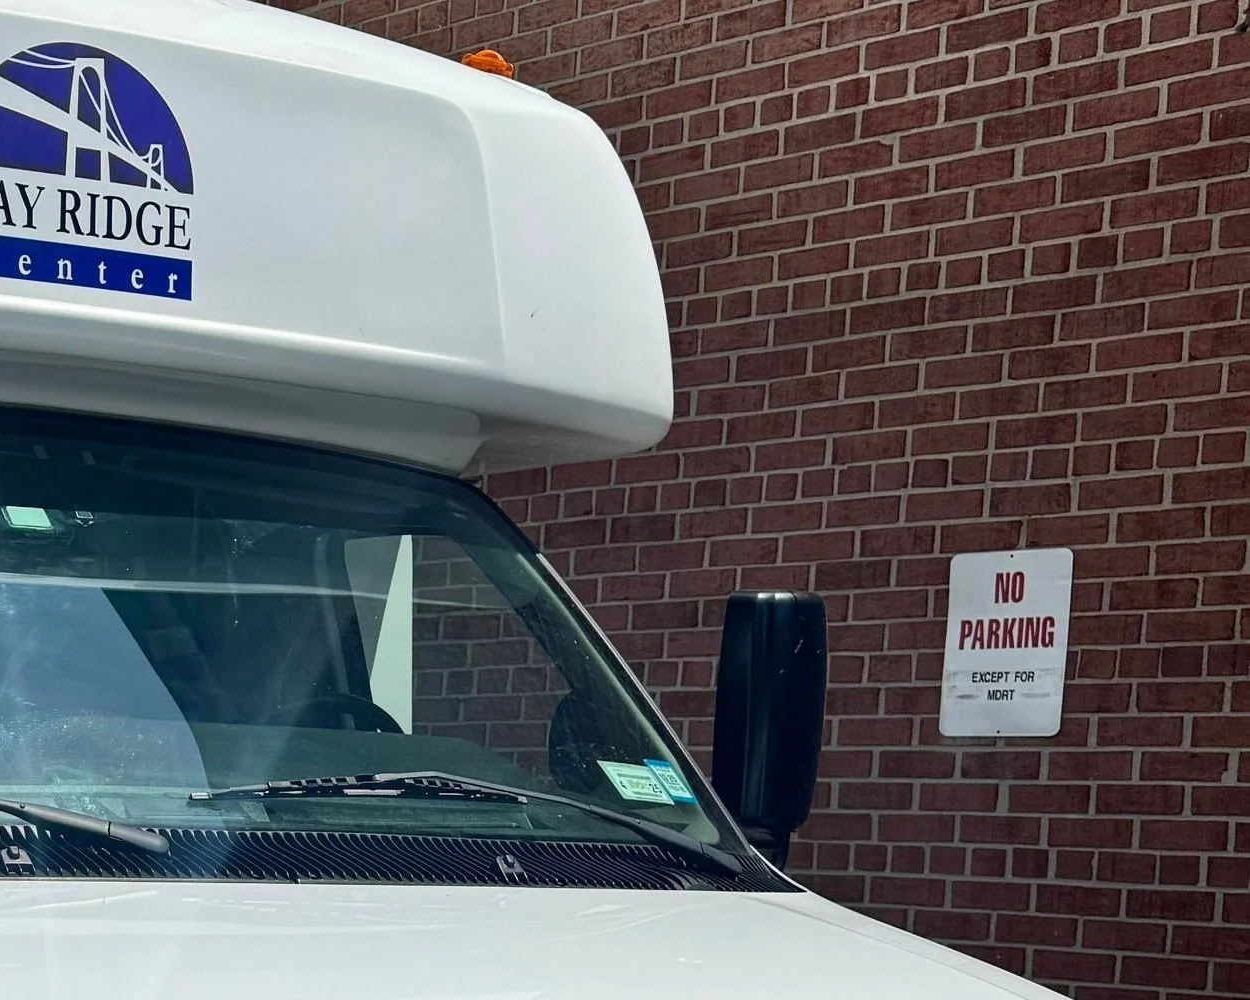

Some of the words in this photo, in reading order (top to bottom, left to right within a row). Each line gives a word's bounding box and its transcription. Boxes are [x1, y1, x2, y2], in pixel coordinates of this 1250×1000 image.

[56, 188, 192, 251] RIDGE
[994, 571, 1025, 604] NO
[958, 616, 1055, 650] PARKING
[971, 671, 1011, 683] EXCEPT
[1014, 671, 1035, 683] FOR
[986, 689, 1015, 701] MDRT
